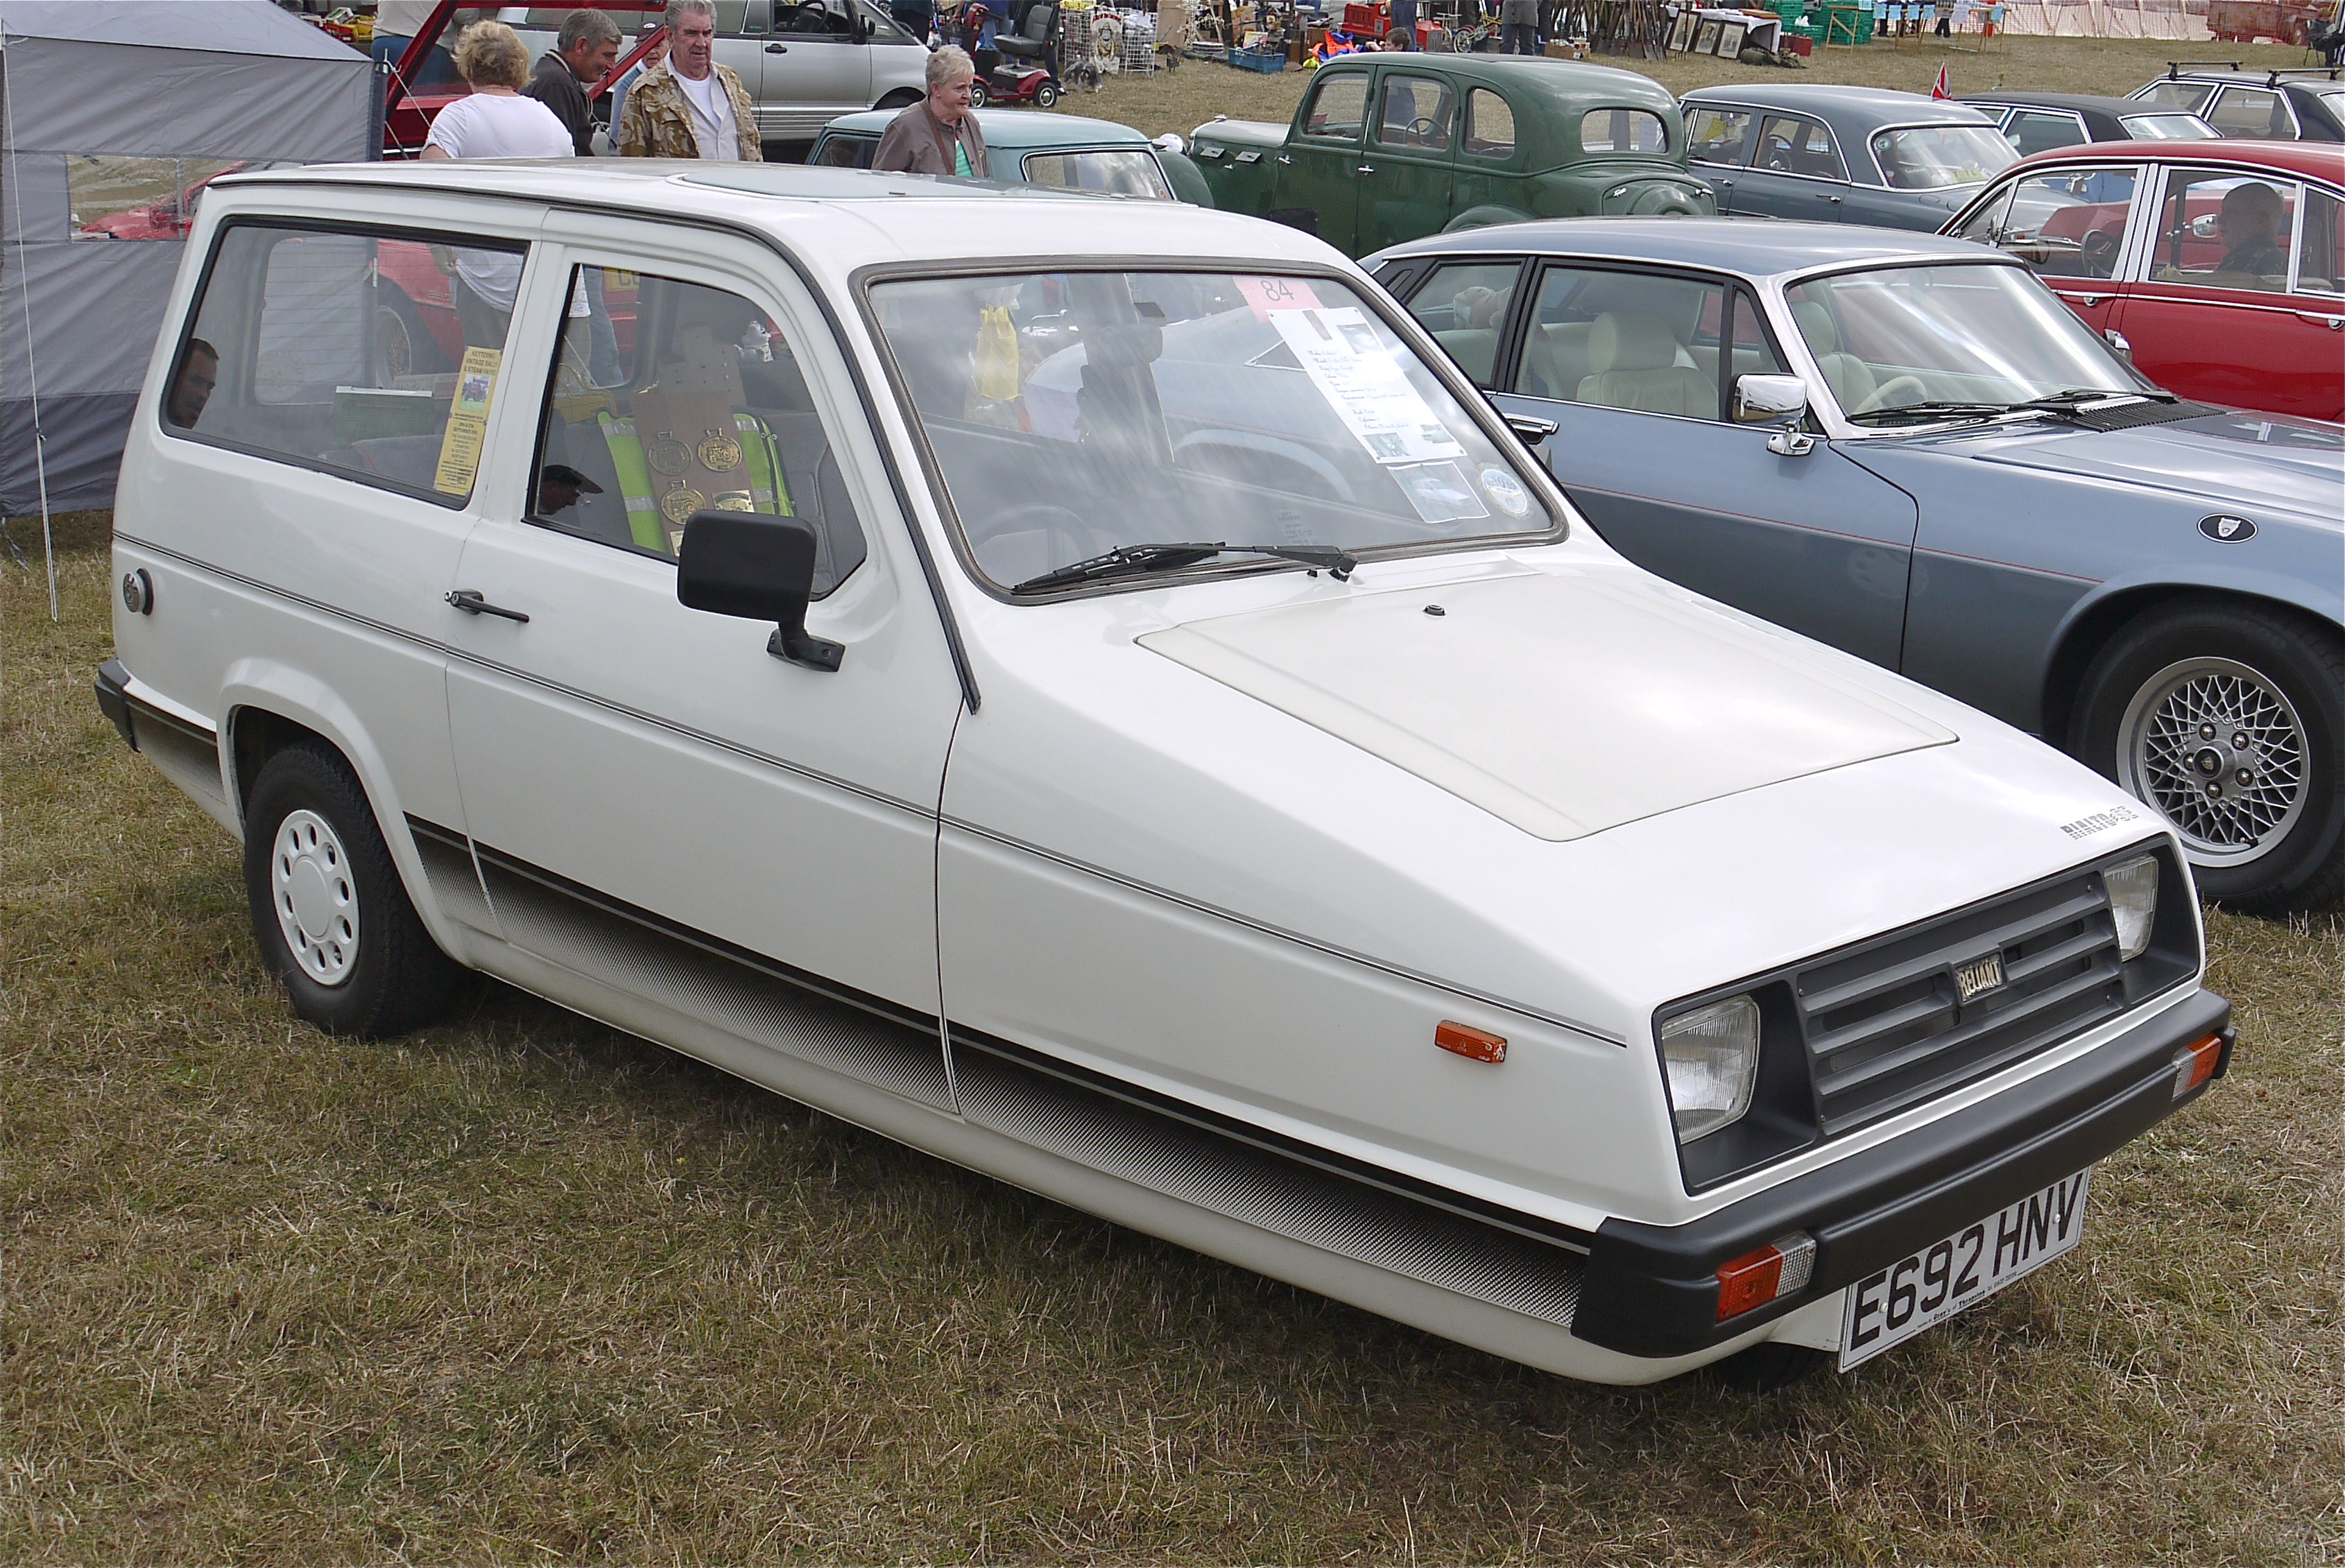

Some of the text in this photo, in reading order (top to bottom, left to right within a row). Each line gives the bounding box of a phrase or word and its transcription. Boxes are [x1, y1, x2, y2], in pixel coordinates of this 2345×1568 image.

[1260, 279, 1294, 302] 84
[2059, 813, 2118, 840] RIALTO
[1957, 958, 2002, 1001] RELIANT
[1850, 1173, 2084, 1352] E692 HNV
